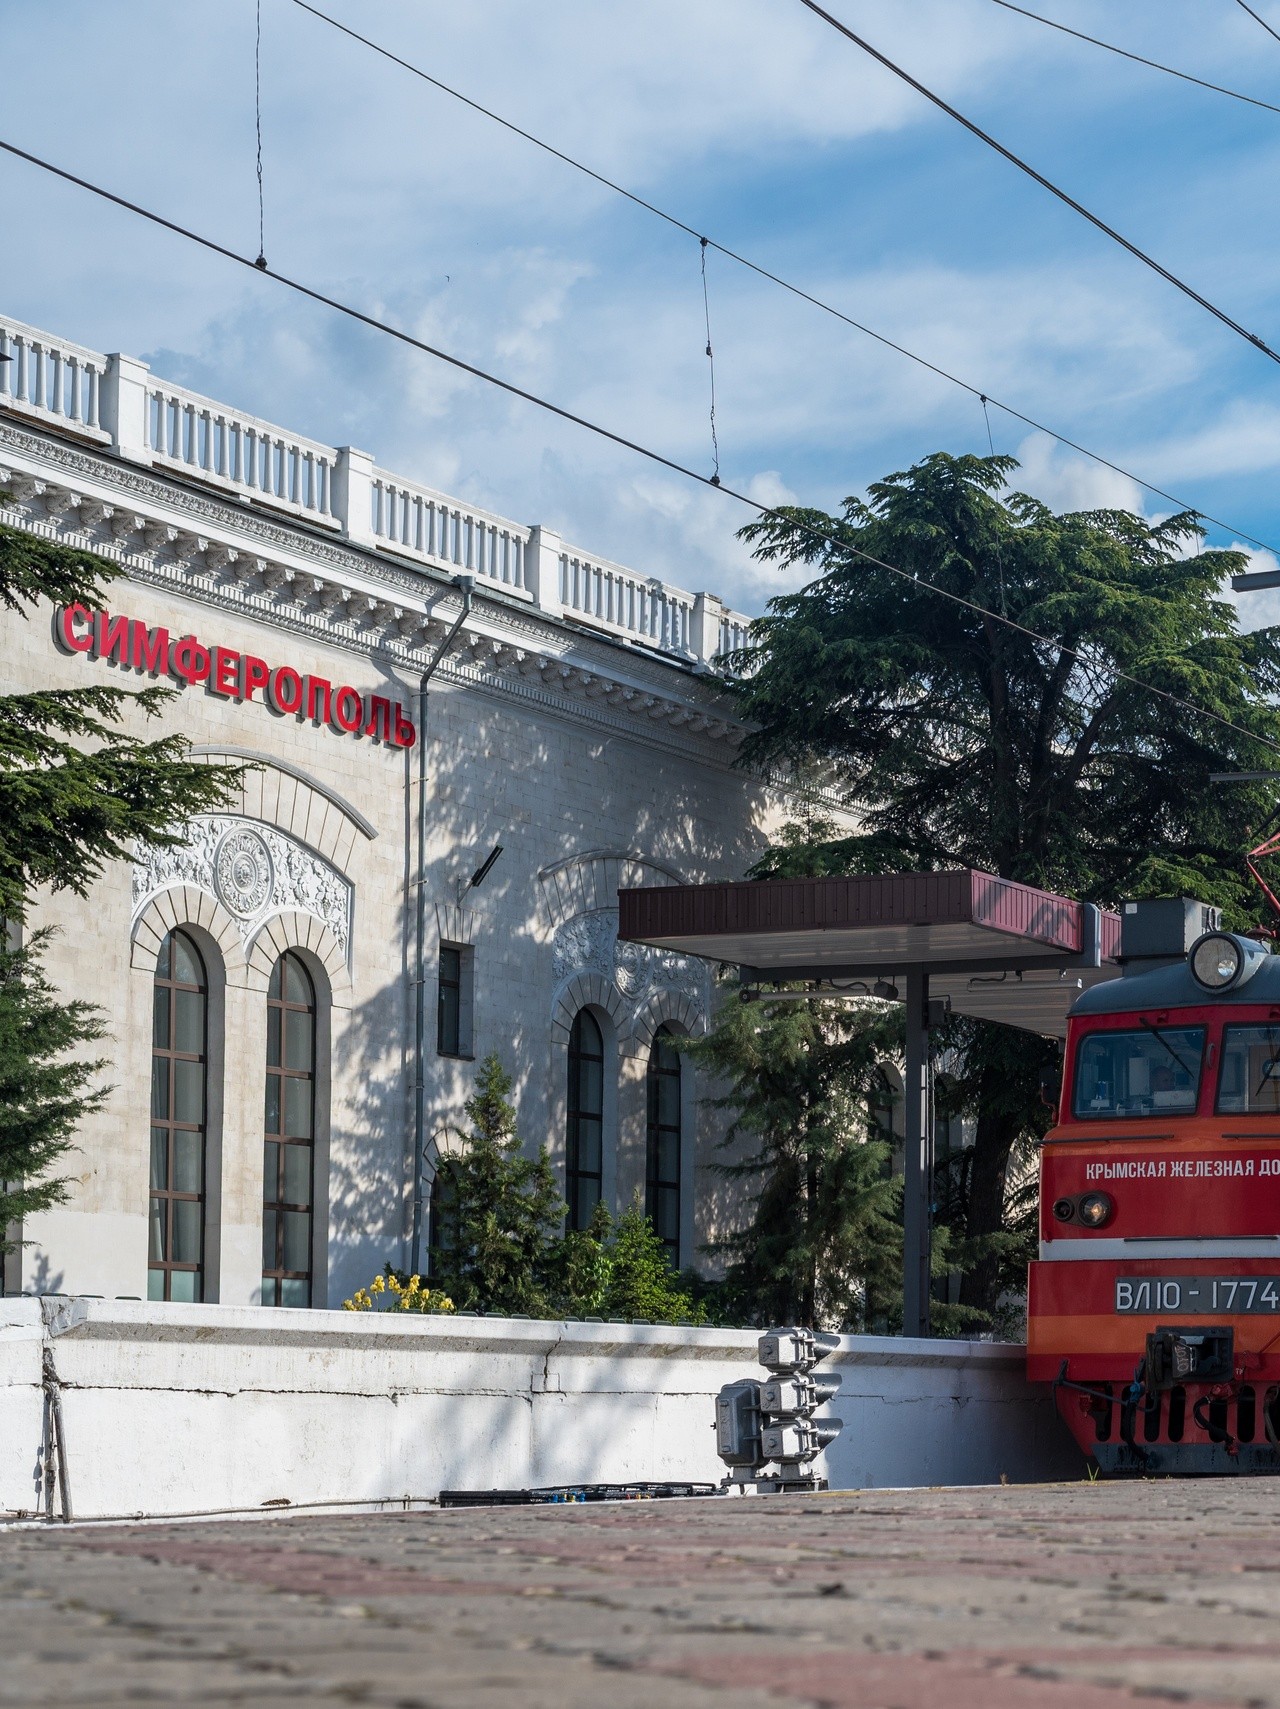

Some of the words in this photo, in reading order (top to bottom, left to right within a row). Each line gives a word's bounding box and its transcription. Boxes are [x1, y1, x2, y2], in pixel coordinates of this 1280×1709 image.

[60, 600, 416, 748] СИМФЕРОПОЛЬ
[1086, 1161, 1167, 1180] КРЫМСКАЯ
[1170, 1159, 1255, 1178] ЖЕЛЕЗНАЯ
[1212, 1281, 1279, 1309] 1774
